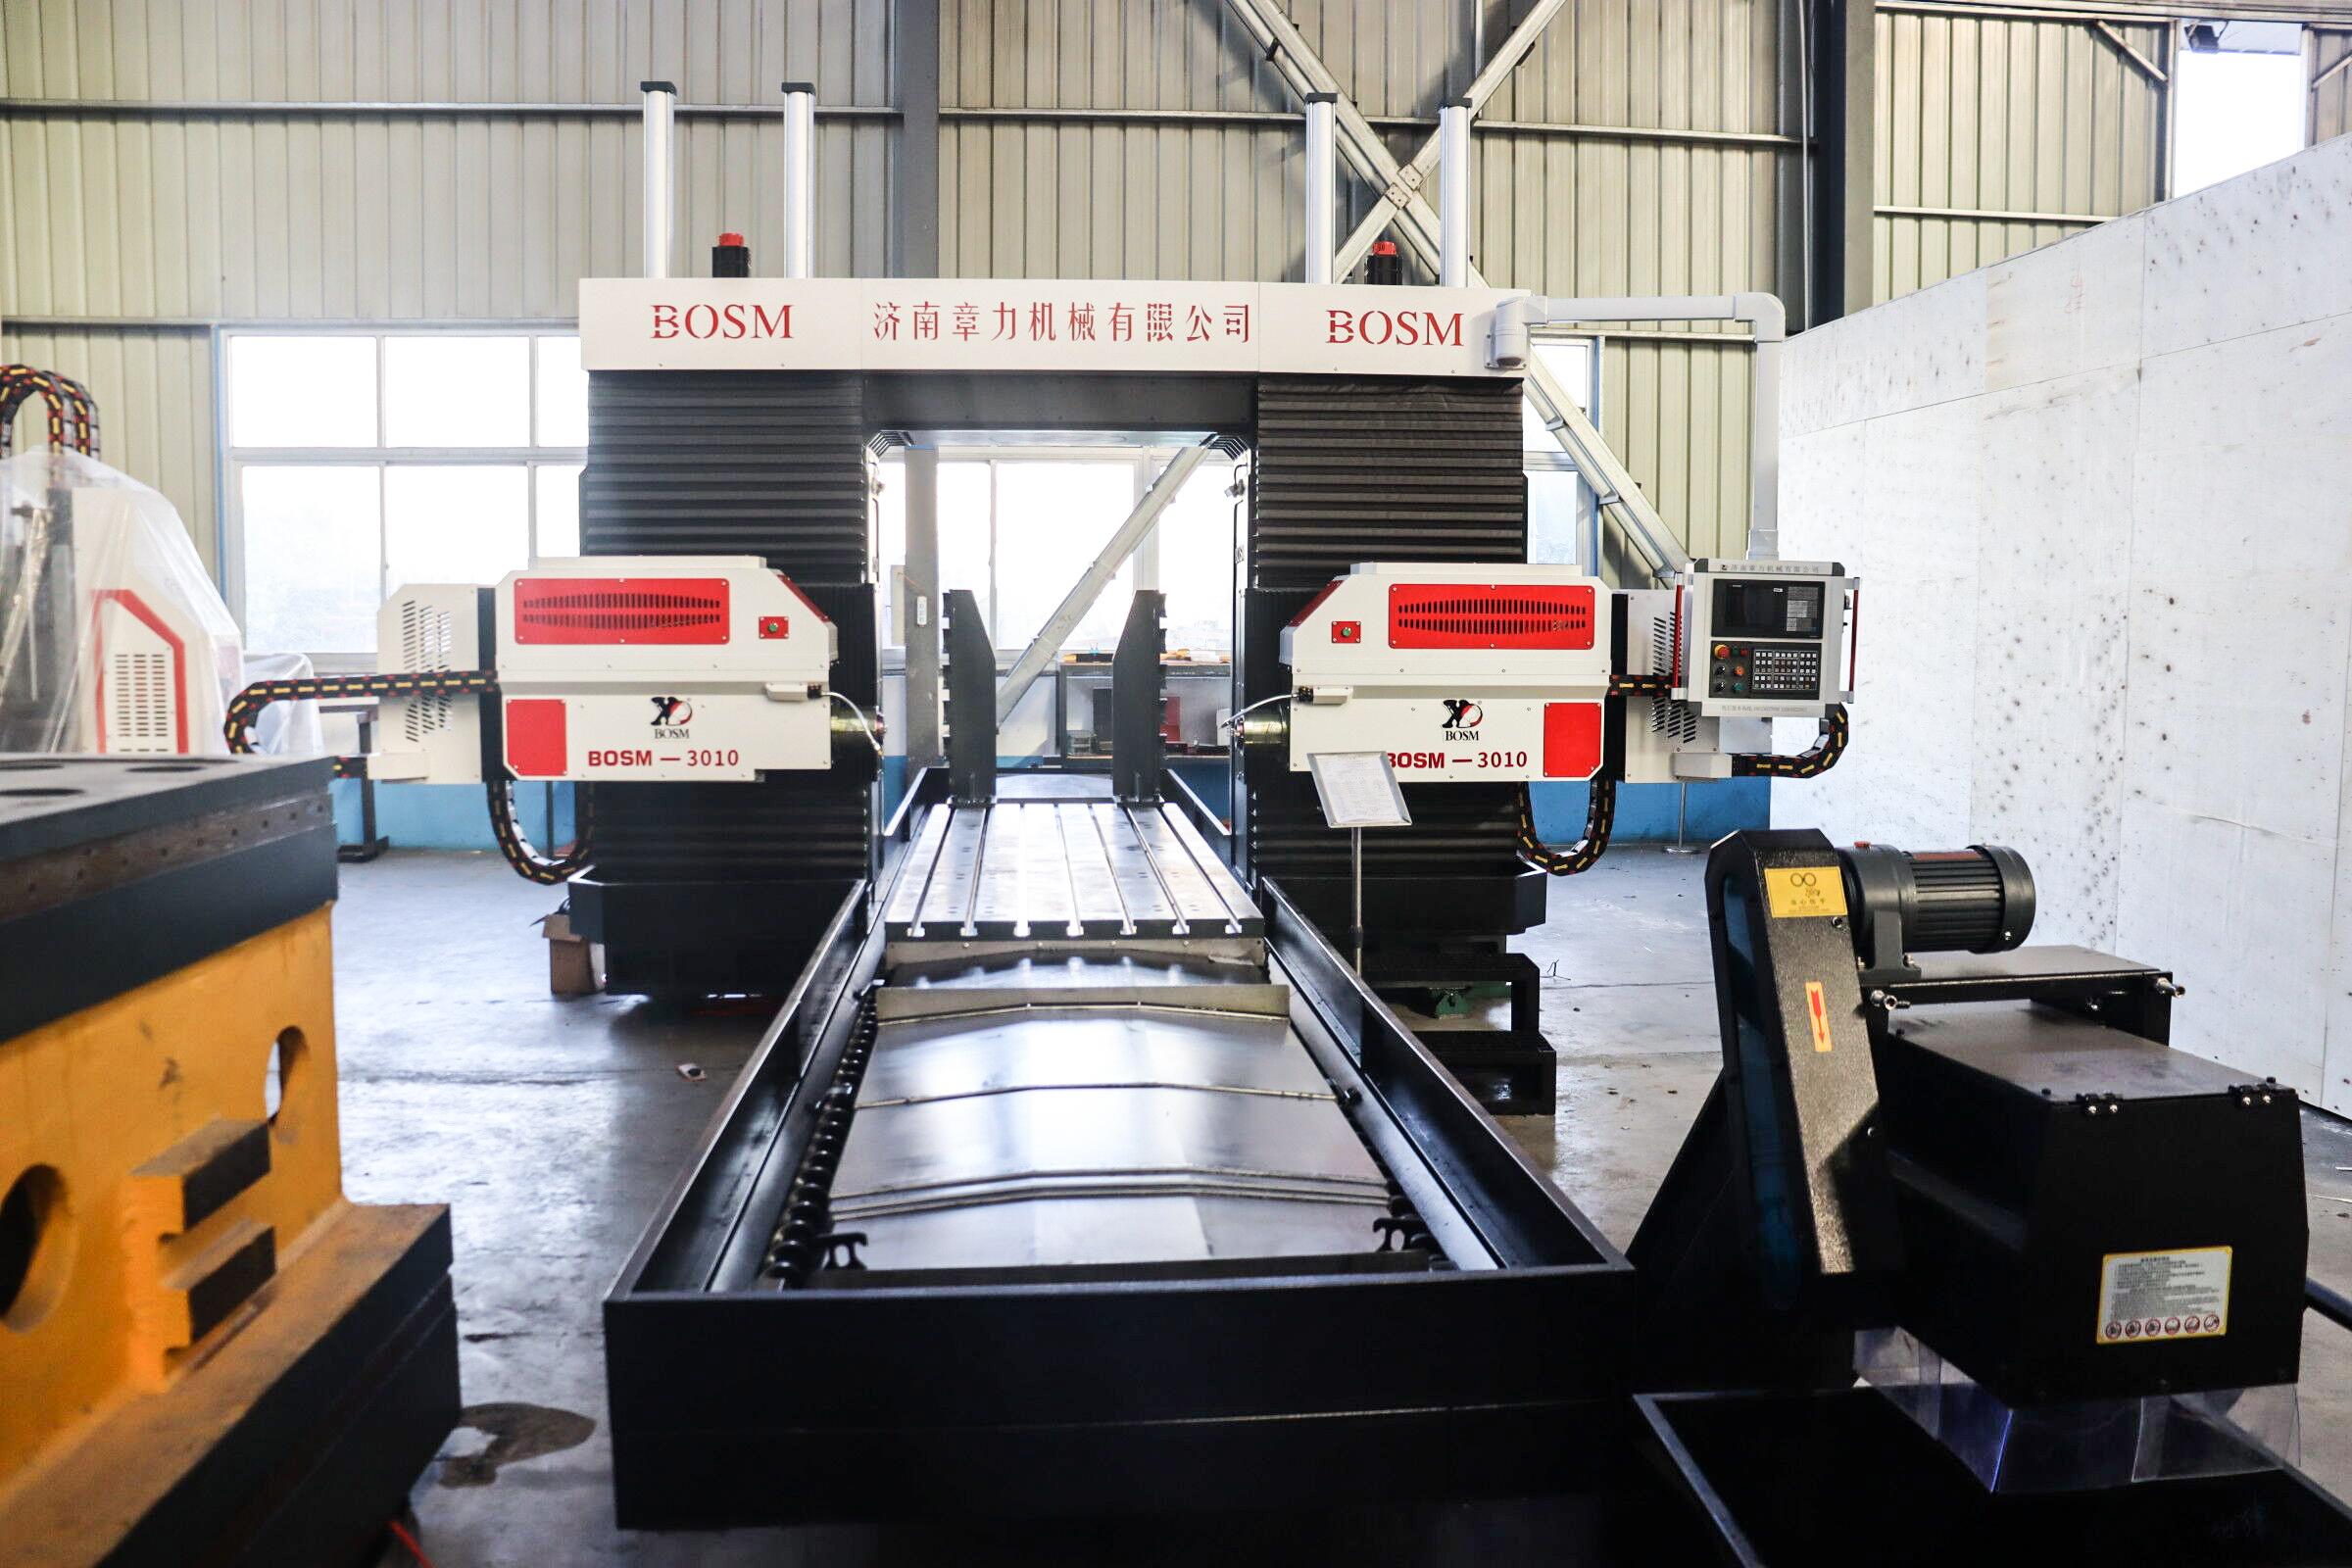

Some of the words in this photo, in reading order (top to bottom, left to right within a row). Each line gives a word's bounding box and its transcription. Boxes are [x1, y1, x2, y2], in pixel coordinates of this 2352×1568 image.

[651, 304, 792, 339] BOSM
[874, 301, 1250, 342] 济南章力机械有限公司
[1326, 309, 1463, 347] BOSM
[654, 728, 690, 740] BOSM
[1445, 730, 1480, 741] BOSM
[587, 748, 653, 767] BOSM
[687, 749, 739, 767] 3010
[1477, 751, 1529, 769] 3010
